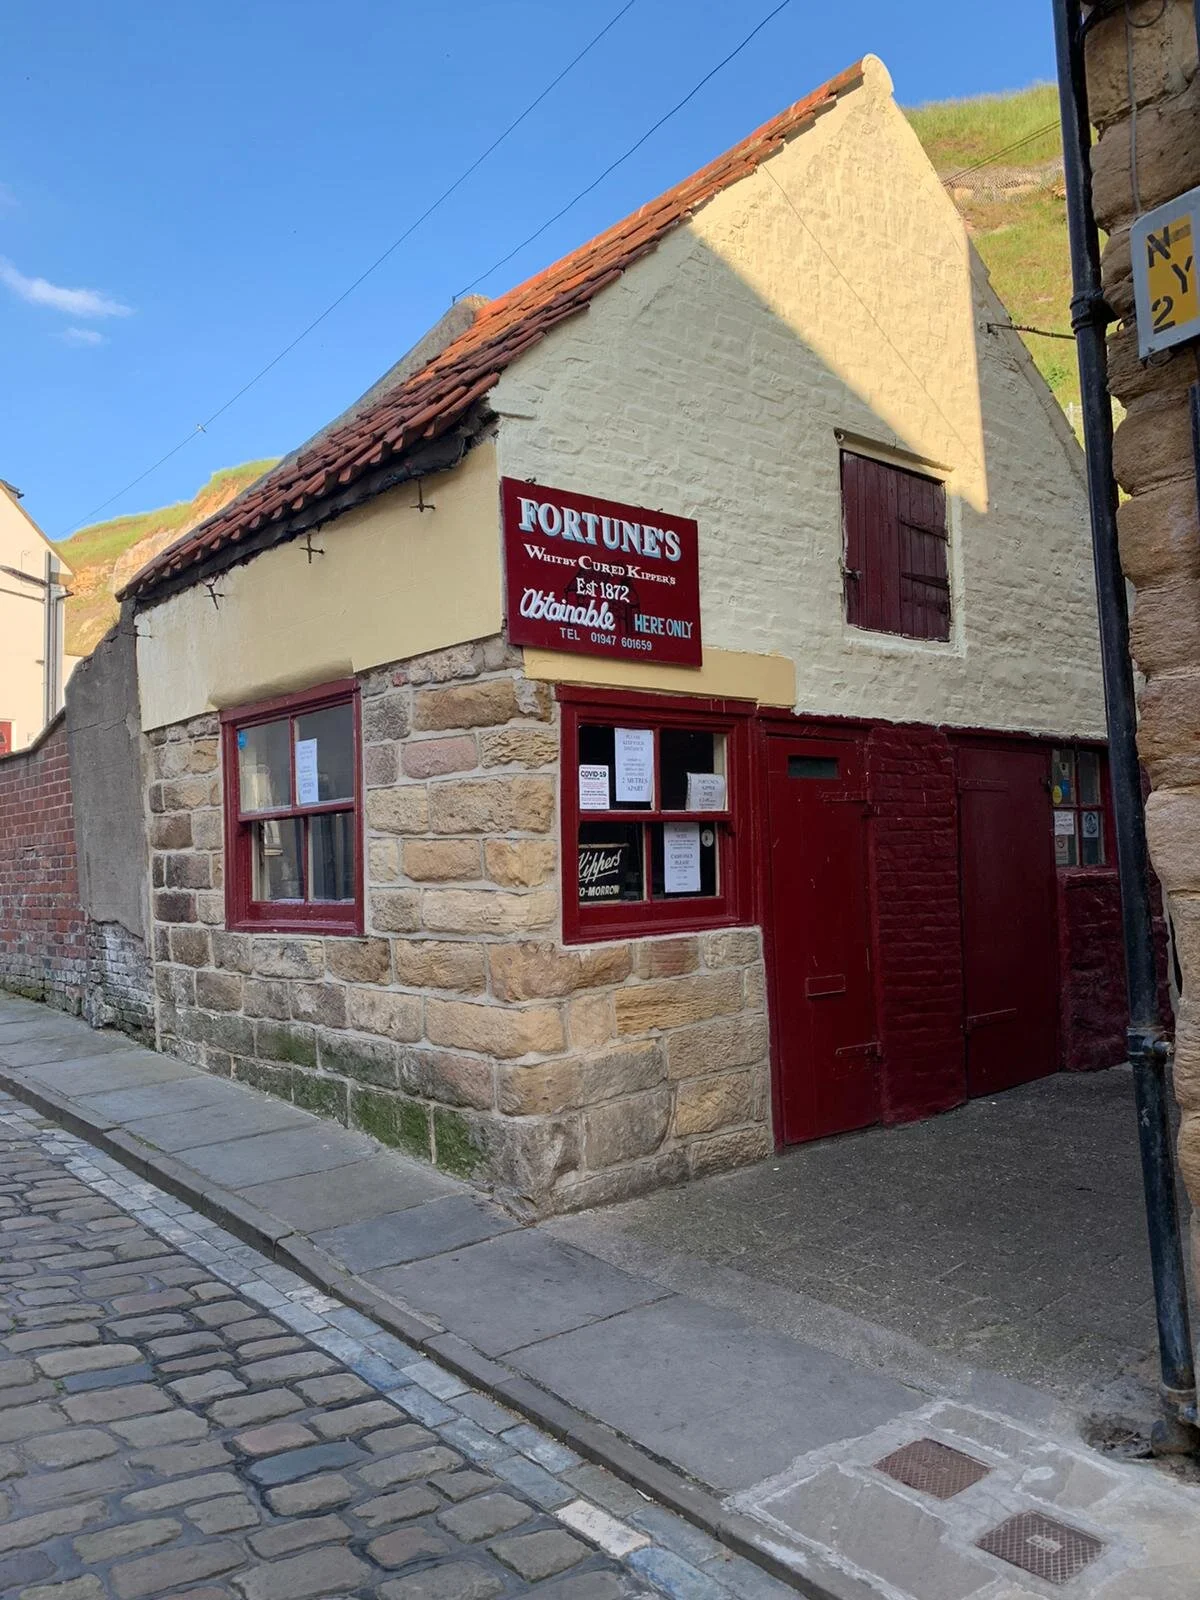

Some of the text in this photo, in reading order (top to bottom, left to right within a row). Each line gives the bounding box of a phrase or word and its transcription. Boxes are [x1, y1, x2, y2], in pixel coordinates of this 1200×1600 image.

[1152, 296, 1176, 334] 2
[517, 496, 682, 561] FORTUNE'S
[524, 544, 577, 567] WHITBY
[578, 556, 624, 576] CURED
[600, 582, 630, 603] 1872
[519, 588, 616, 631] Obtainable
[560, 627, 652, 651] TEL 01947 601659
[634, 614, 694, 639] HERE ONLY
[580, 770, 607, 778] COVID-19
[579, 885, 620, 897] O-MORROW
